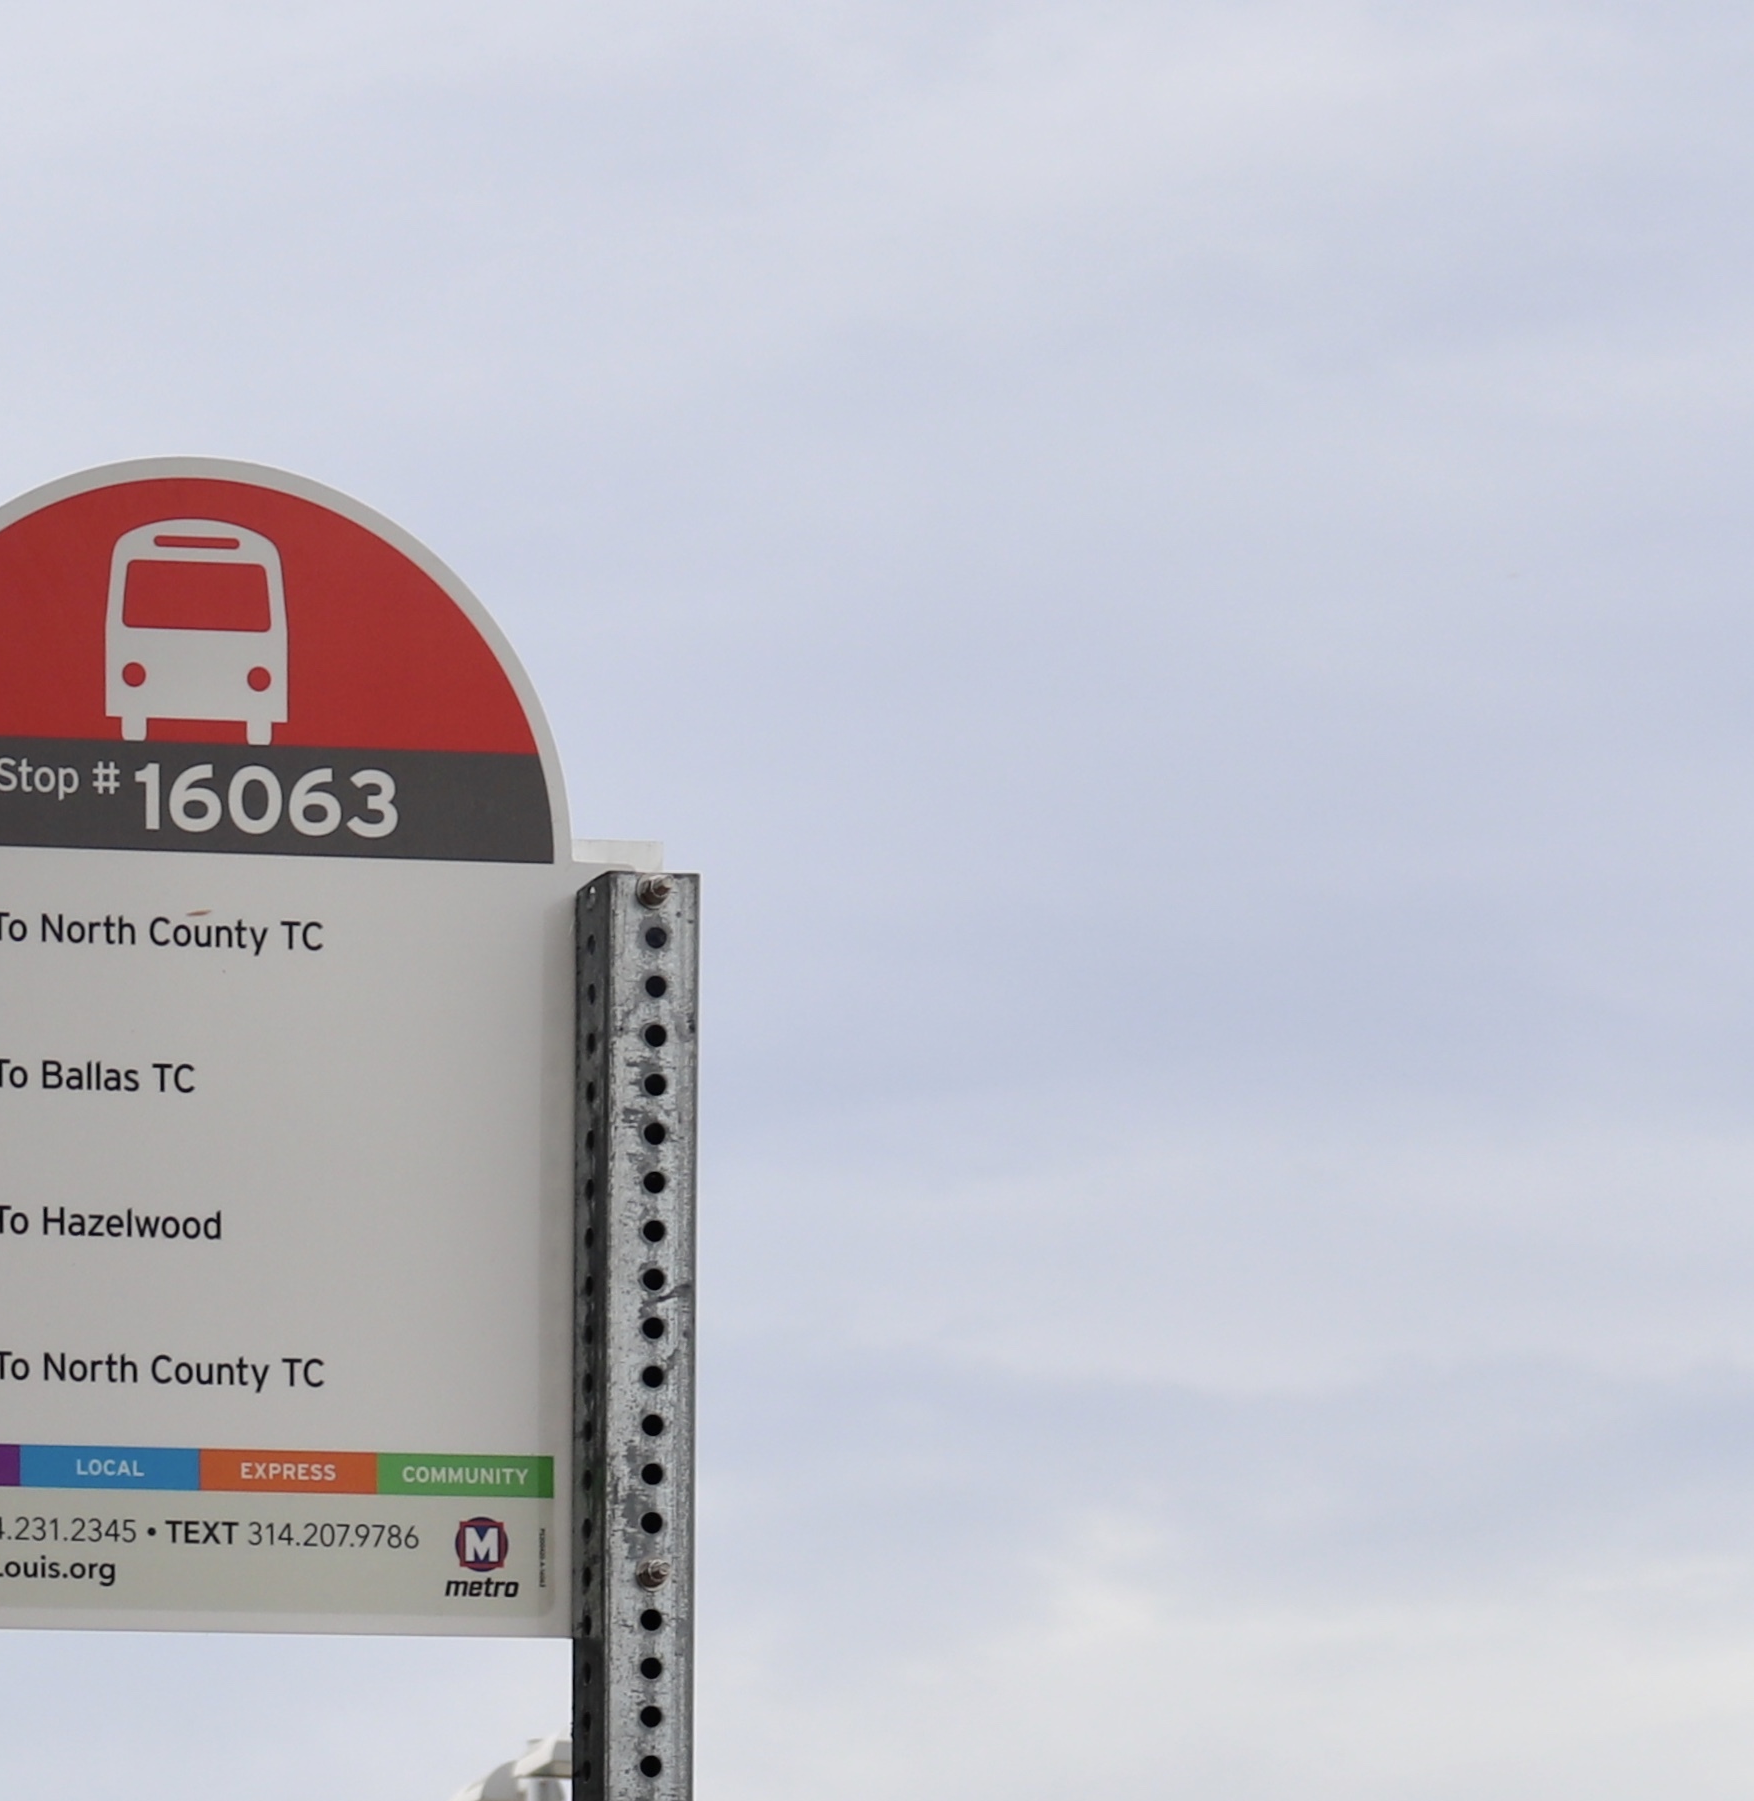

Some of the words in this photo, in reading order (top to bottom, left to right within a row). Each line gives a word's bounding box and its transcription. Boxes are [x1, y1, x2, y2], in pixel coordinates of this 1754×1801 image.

[92, 761, 121, 795] #
[134, 762, 398, 838] 16063
[41, 913, 136, 945] North
[149, 916, 268, 956] County
[280, 920, 323, 951] TC
[42, 1060, 140, 1092] Ballas
[152, 1063, 195, 1094] TC
[42, 1206, 222, 1240] Hazelwood
[43, 1352, 138, 1383] North
[151, 1354, 270, 1393] County
[281, 1358, 324, 1388] TC
[76, 1458, 145, 1477] LOCAL
[240, 1462, 336, 1481] EXPRESS
[401, 1465, 528, 1485] COMMUNITY
[164, 1520, 239, 1545] TEXT
[248, 1521, 420, 1550] 314.207.9786
[445, 1577, 520, 1598] metro
